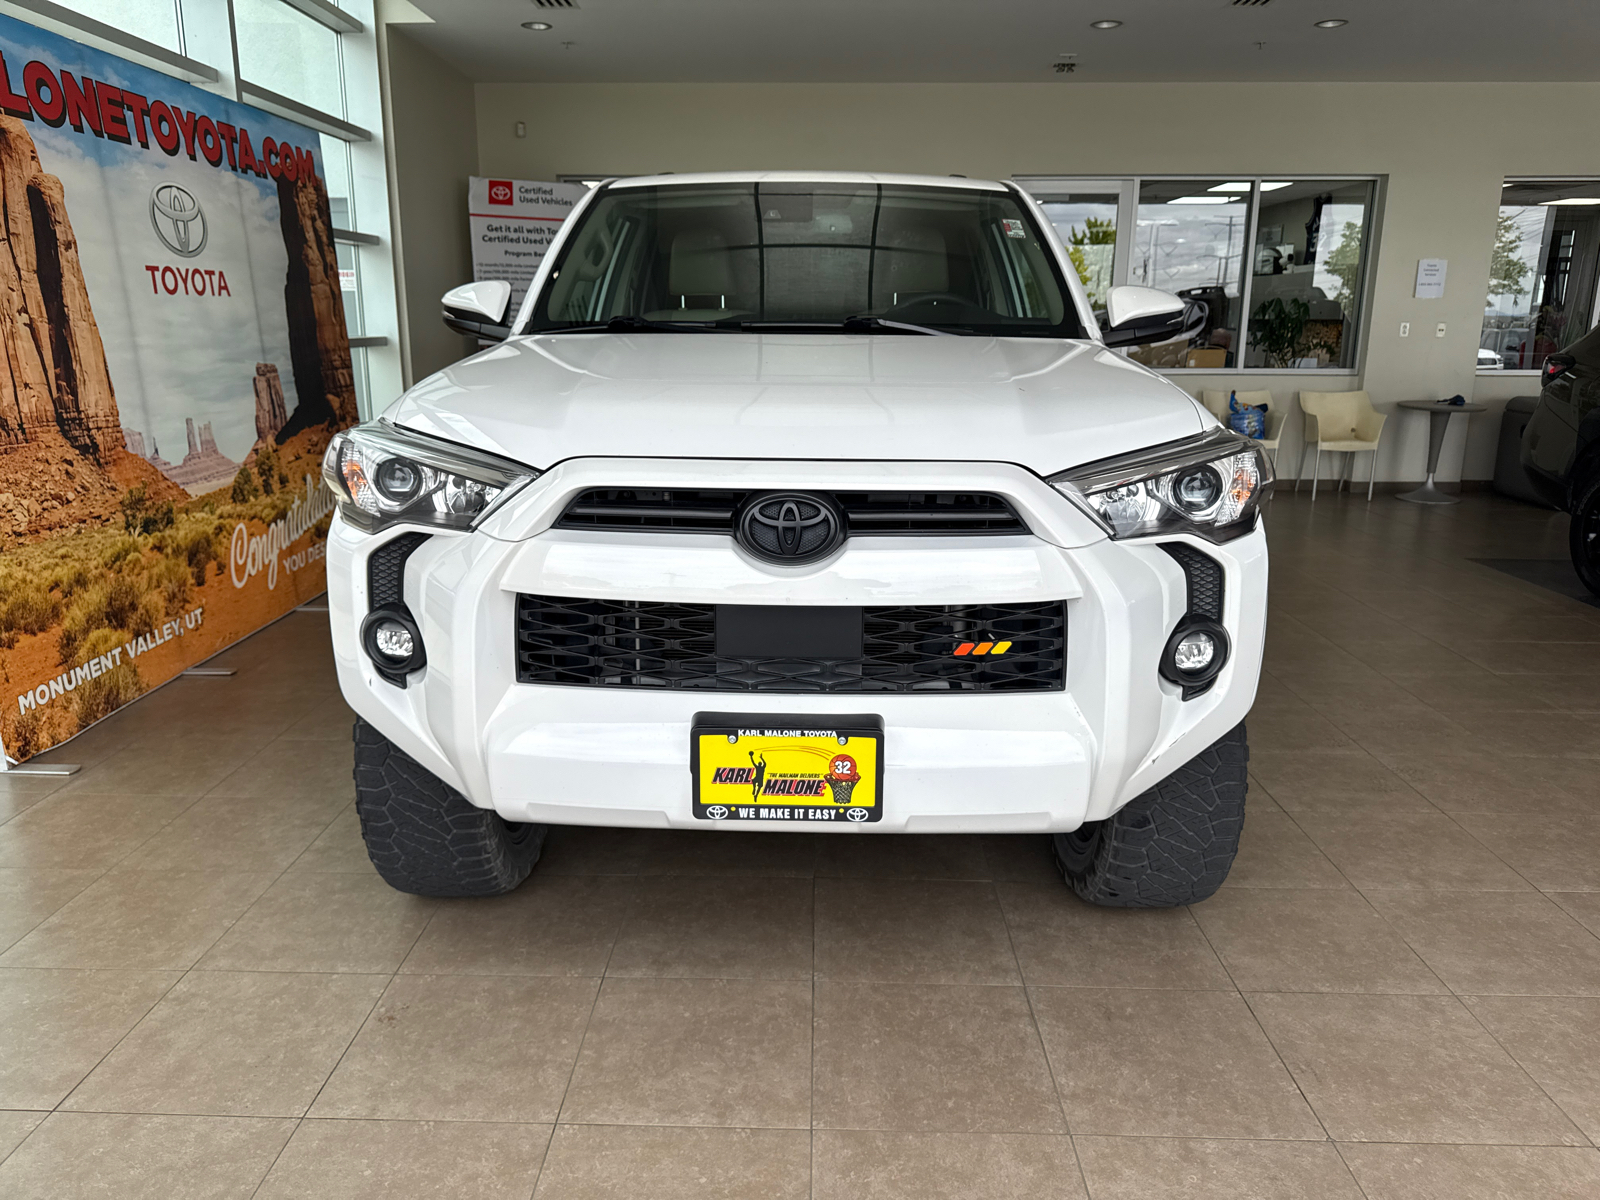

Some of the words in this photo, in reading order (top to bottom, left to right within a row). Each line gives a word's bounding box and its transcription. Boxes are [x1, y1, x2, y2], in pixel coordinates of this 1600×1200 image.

[518, 186, 553, 196] Certified
[519, 196, 539, 205] Used
[541, 197, 573, 207] Vehicles
[487, 224, 503, 234] Get
[505, 225, 512, 234] it
[513, 226, 524, 235] all
[526, 227, 545, 236] with
[482, 234, 520, 244] Certified
[522, 236, 544, 245] Used
[504, 249, 533, 258] Program
[145, 265, 231, 297] TOYOTA
[283, 550, 306, 575] YOU
[18, 647, 122, 716] MONUMENT
[125, 618, 184, 659] VALLEY,
[185, 607, 203, 629] UT
[738, 729, 762, 737] KARL
[804, 730, 837, 738] TOYOTA
[834, 761, 851, 774] 32
[711, 767, 755, 784] KARL
[762, 778, 827, 797] MALONE
[739, 808, 756, 819] WE
[760, 808, 790, 819] MAKE
[794, 809, 804, 819] IT
[808, 809, 836, 820] EASY
